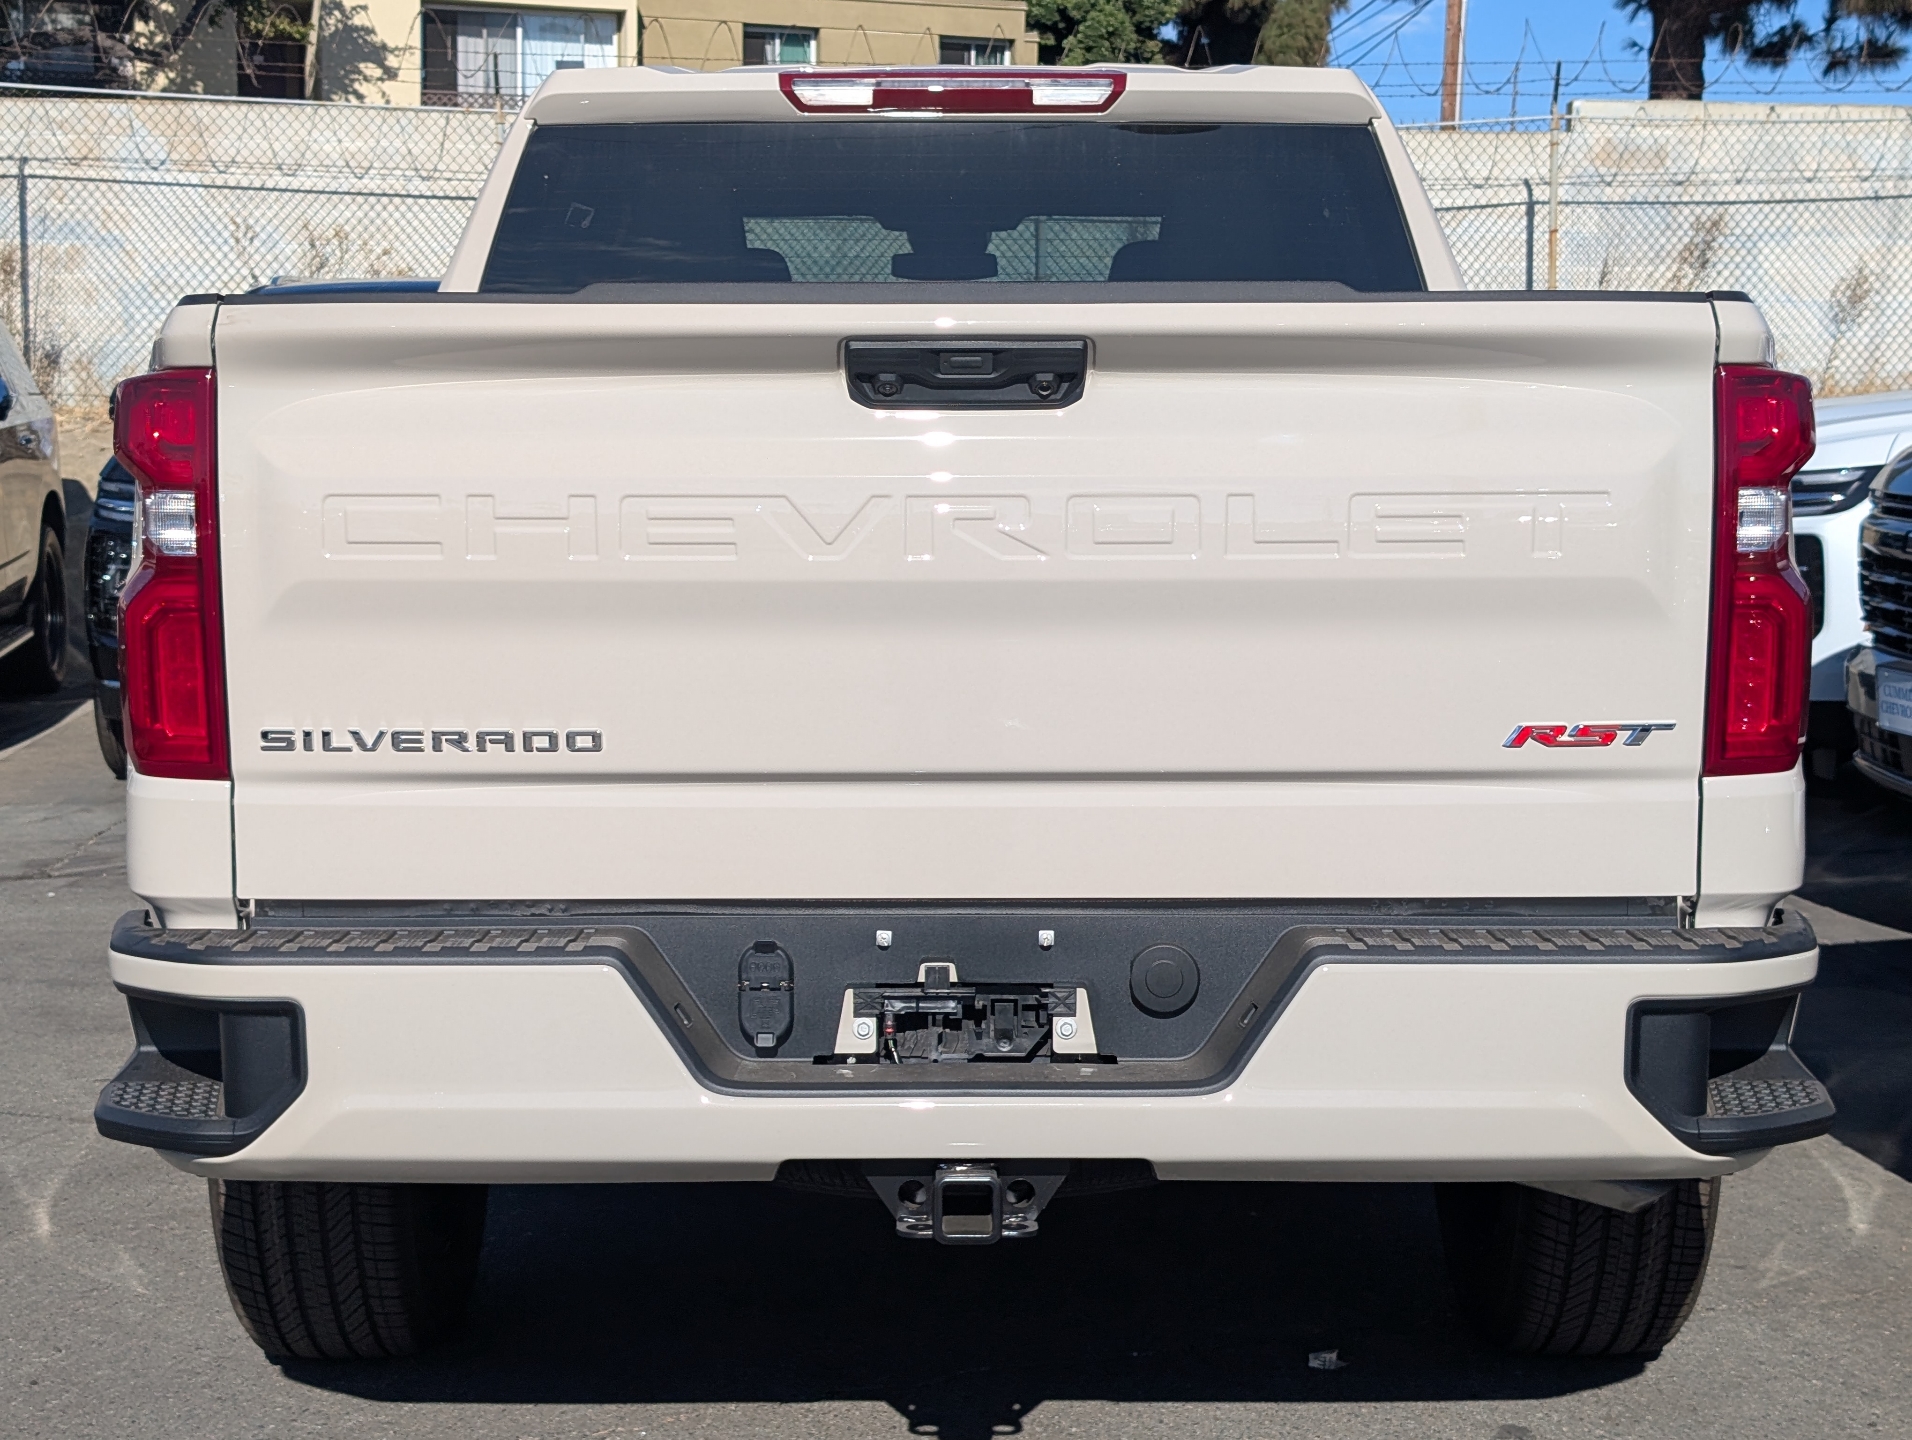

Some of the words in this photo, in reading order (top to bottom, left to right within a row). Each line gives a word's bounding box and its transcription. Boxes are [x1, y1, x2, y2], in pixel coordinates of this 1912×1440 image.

[322, 490, 1612, 561] CHEVROLET
[259, 728, 603, 753] SILVERADO
[1501, 722, 1677, 749] RST
